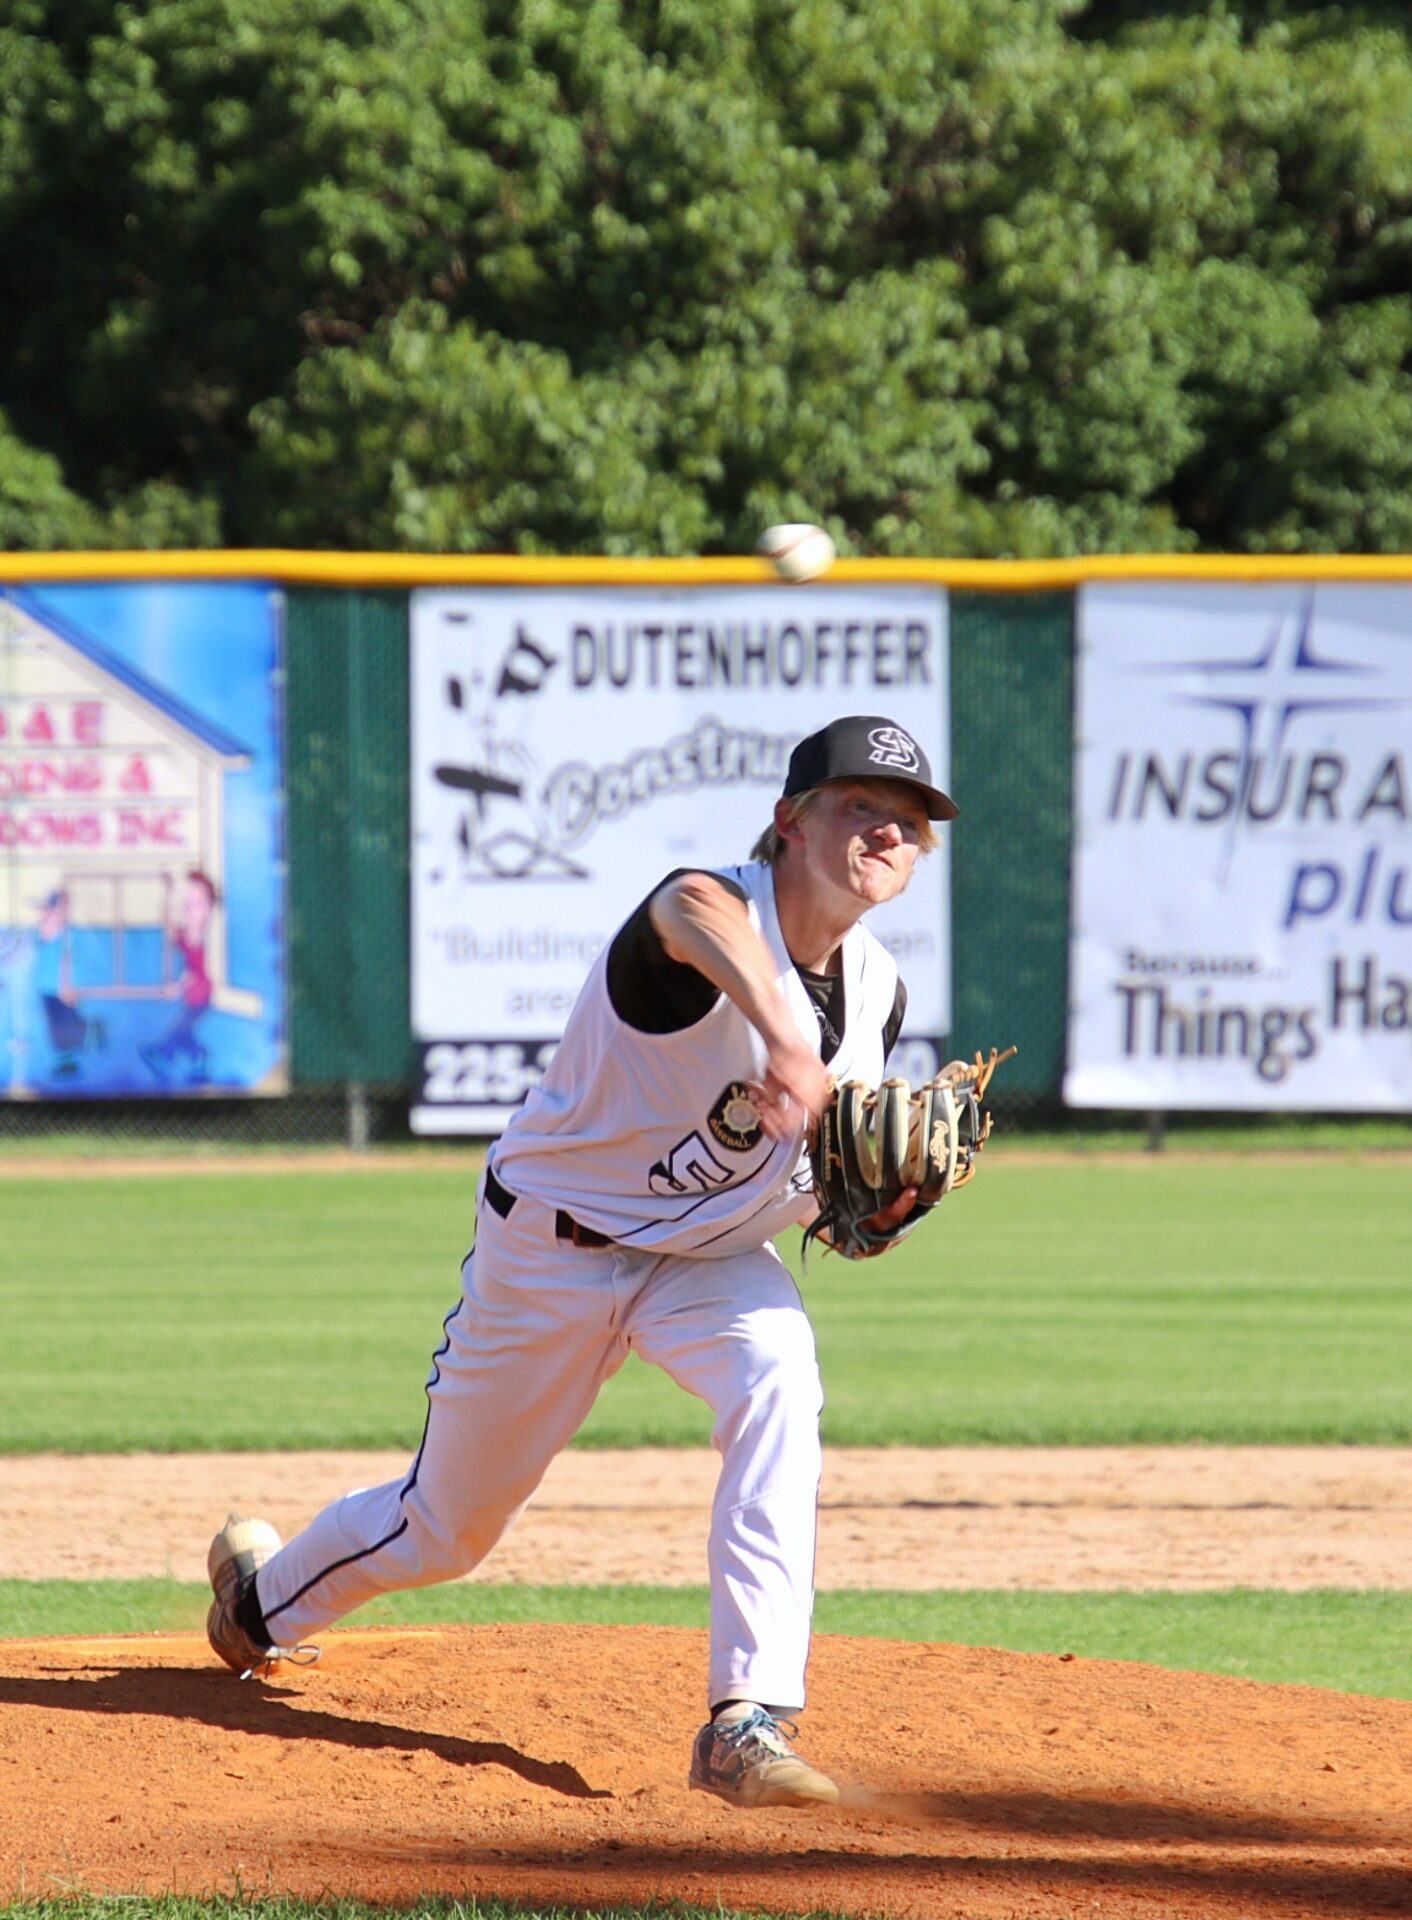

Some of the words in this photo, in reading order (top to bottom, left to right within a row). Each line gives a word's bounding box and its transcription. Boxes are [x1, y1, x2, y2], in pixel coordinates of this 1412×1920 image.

[570, 622, 931, 687] DUTENHOFFER
[1105, 751, 1407, 822] INSURA
[1113, 981, 1318, 1083] Things
[708, 1117, 753, 1148] BASEBALL
